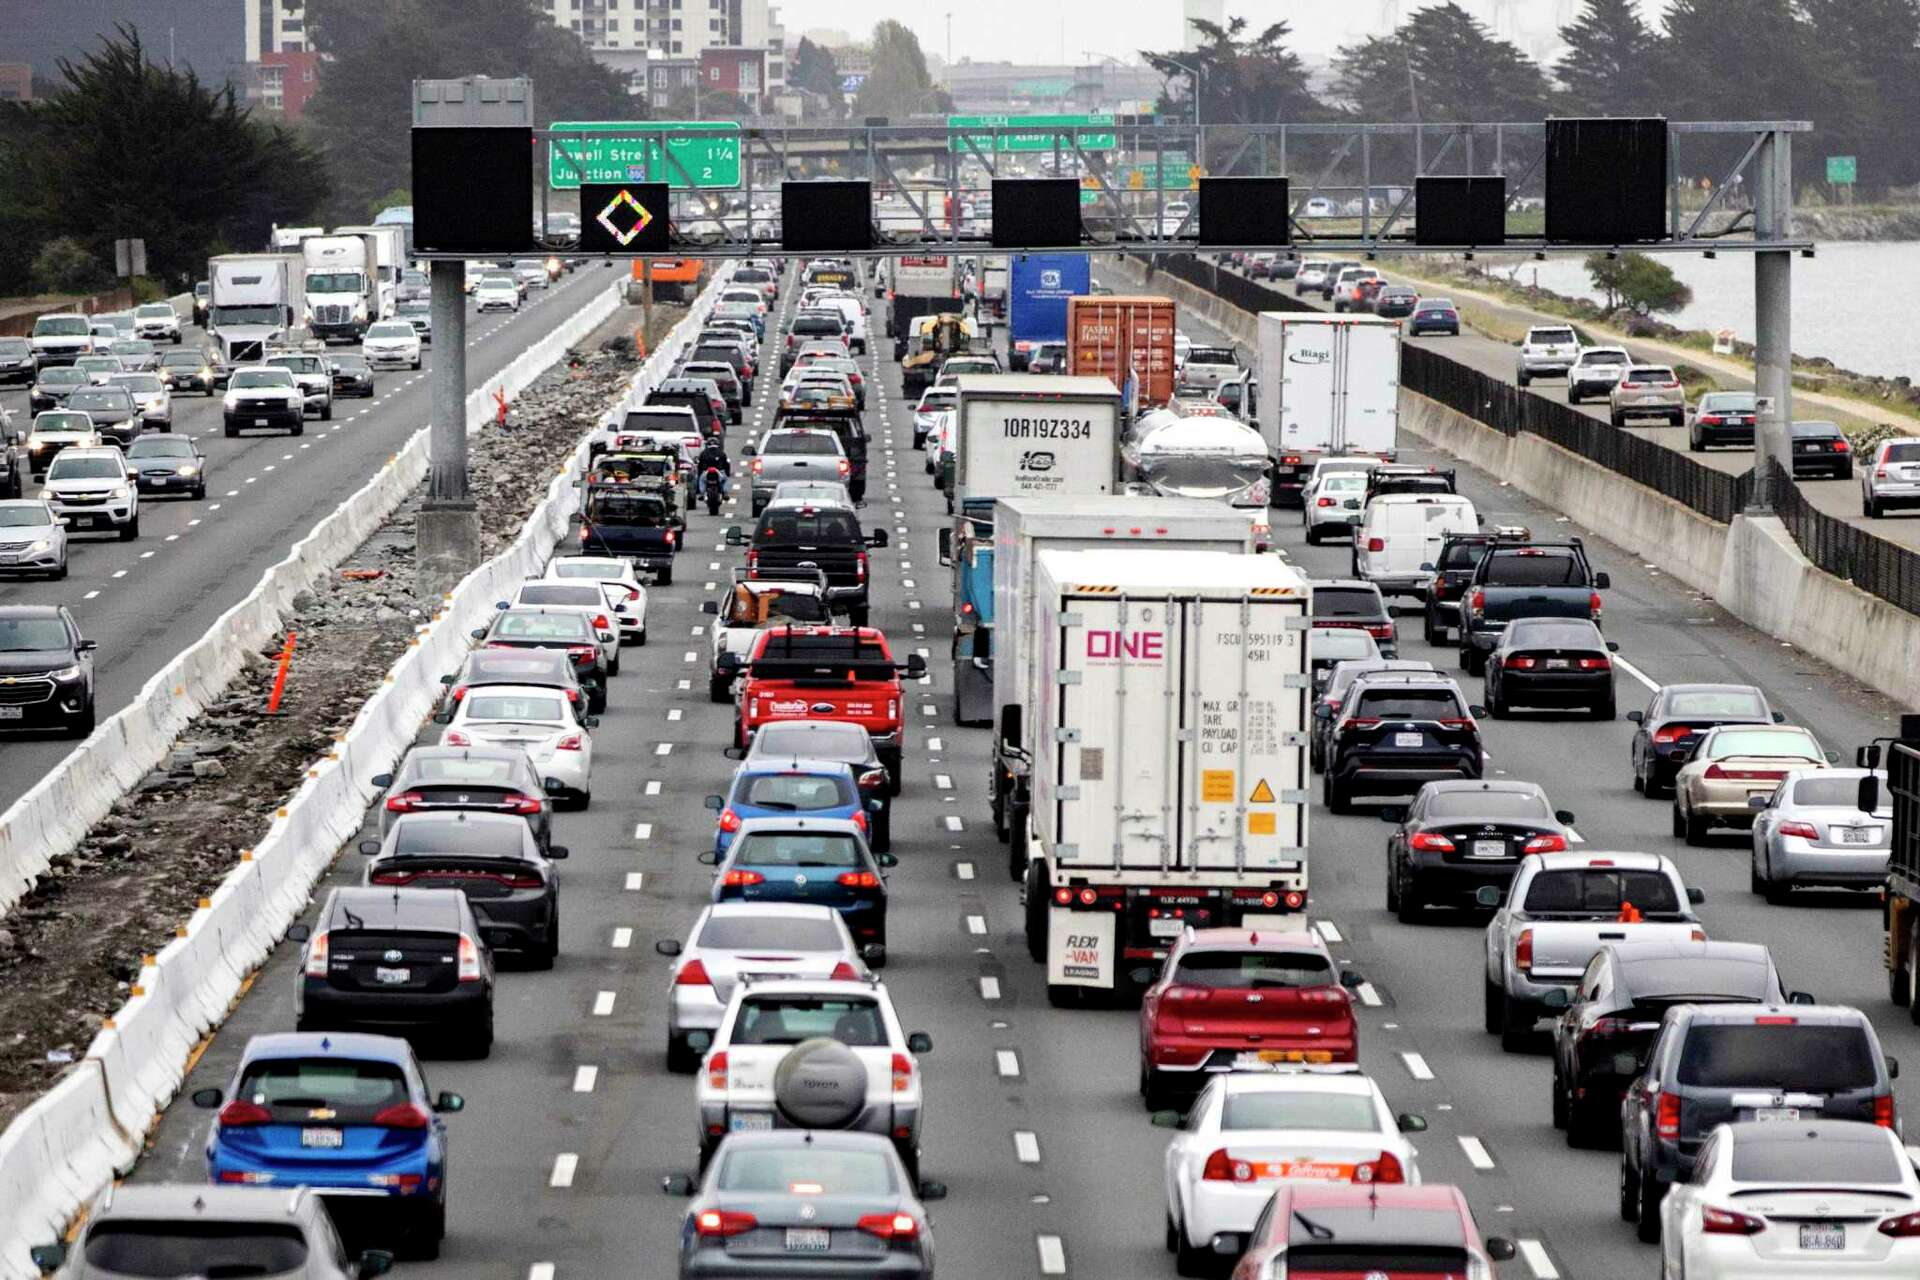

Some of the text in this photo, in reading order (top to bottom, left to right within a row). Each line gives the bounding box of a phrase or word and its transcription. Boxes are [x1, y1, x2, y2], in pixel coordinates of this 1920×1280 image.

[555, 149, 602, 161] Pwell
[610, 149, 658, 161] Stret
[702, 167, 713, 179] 2
[1301, 349, 1329, 361] Biagi
[1003, 418, 1091, 439] 10R19Z334
[1087, 631, 1163, 659] ONE
[1217, 633, 1241, 645] FSCU
[1287, 634, 1296, 647] 3
[1203, 701, 1240, 712] MAX GR
[1203, 714, 1223, 726] TARE
[1202, 728, 1238, 740] PAYLOAD
[1201, 742, 1238, 753] CU CAP
[803, 1079, 840, 1088] TOYOTA
[1289, 1163, 1340, 1177] Caltrans
